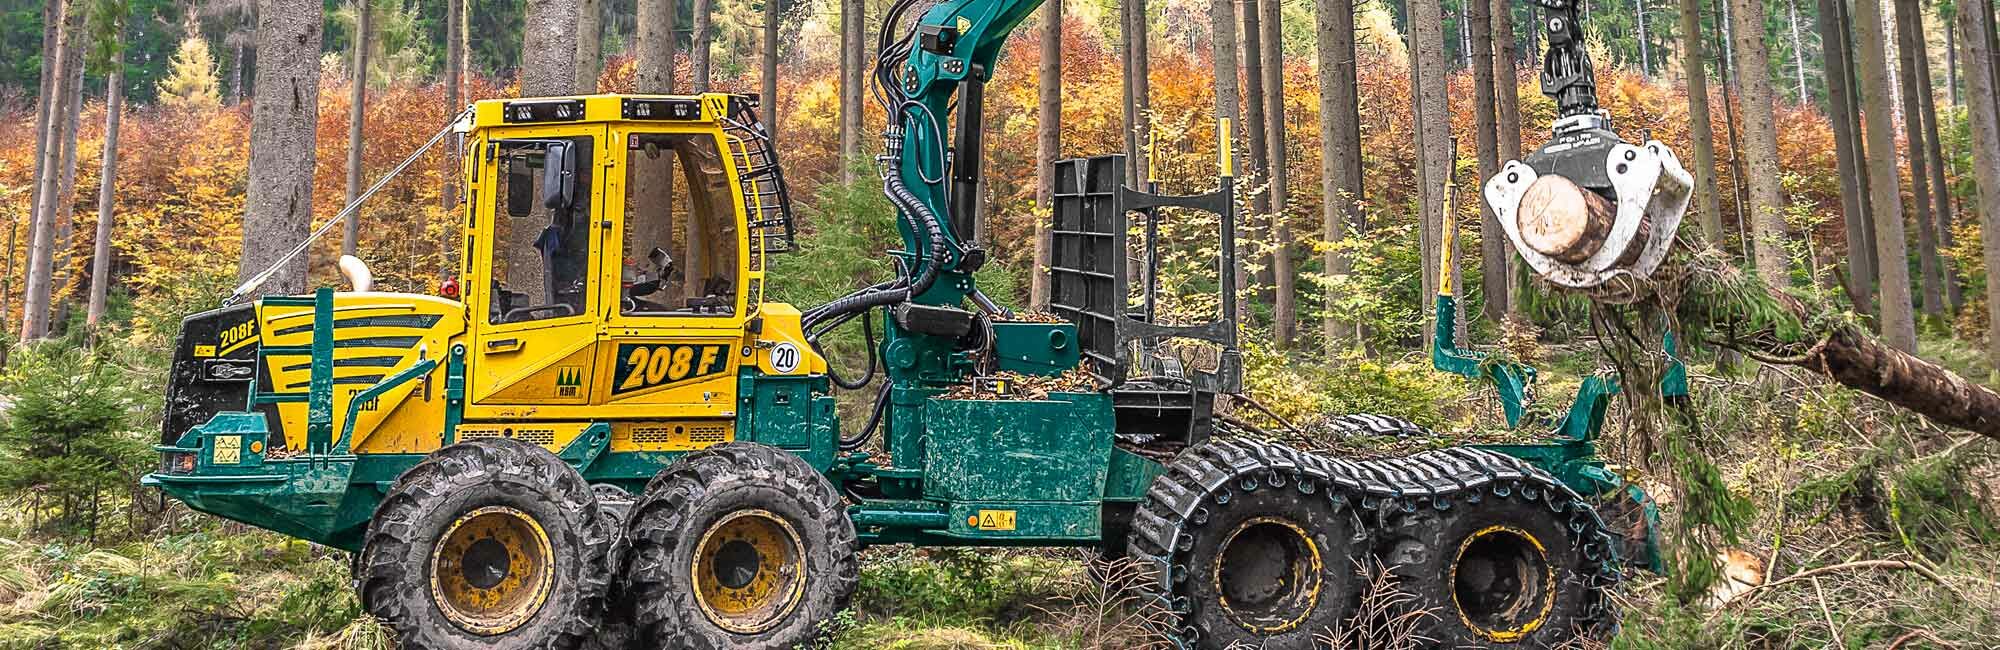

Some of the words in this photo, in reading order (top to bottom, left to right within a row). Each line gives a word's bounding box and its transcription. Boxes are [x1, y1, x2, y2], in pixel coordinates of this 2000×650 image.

[220, 319, 255, 348] 208F
[619, 346, 694, 391] 208
[696, 346, 720, 376] F
[776, 347, 795, 369] 20
